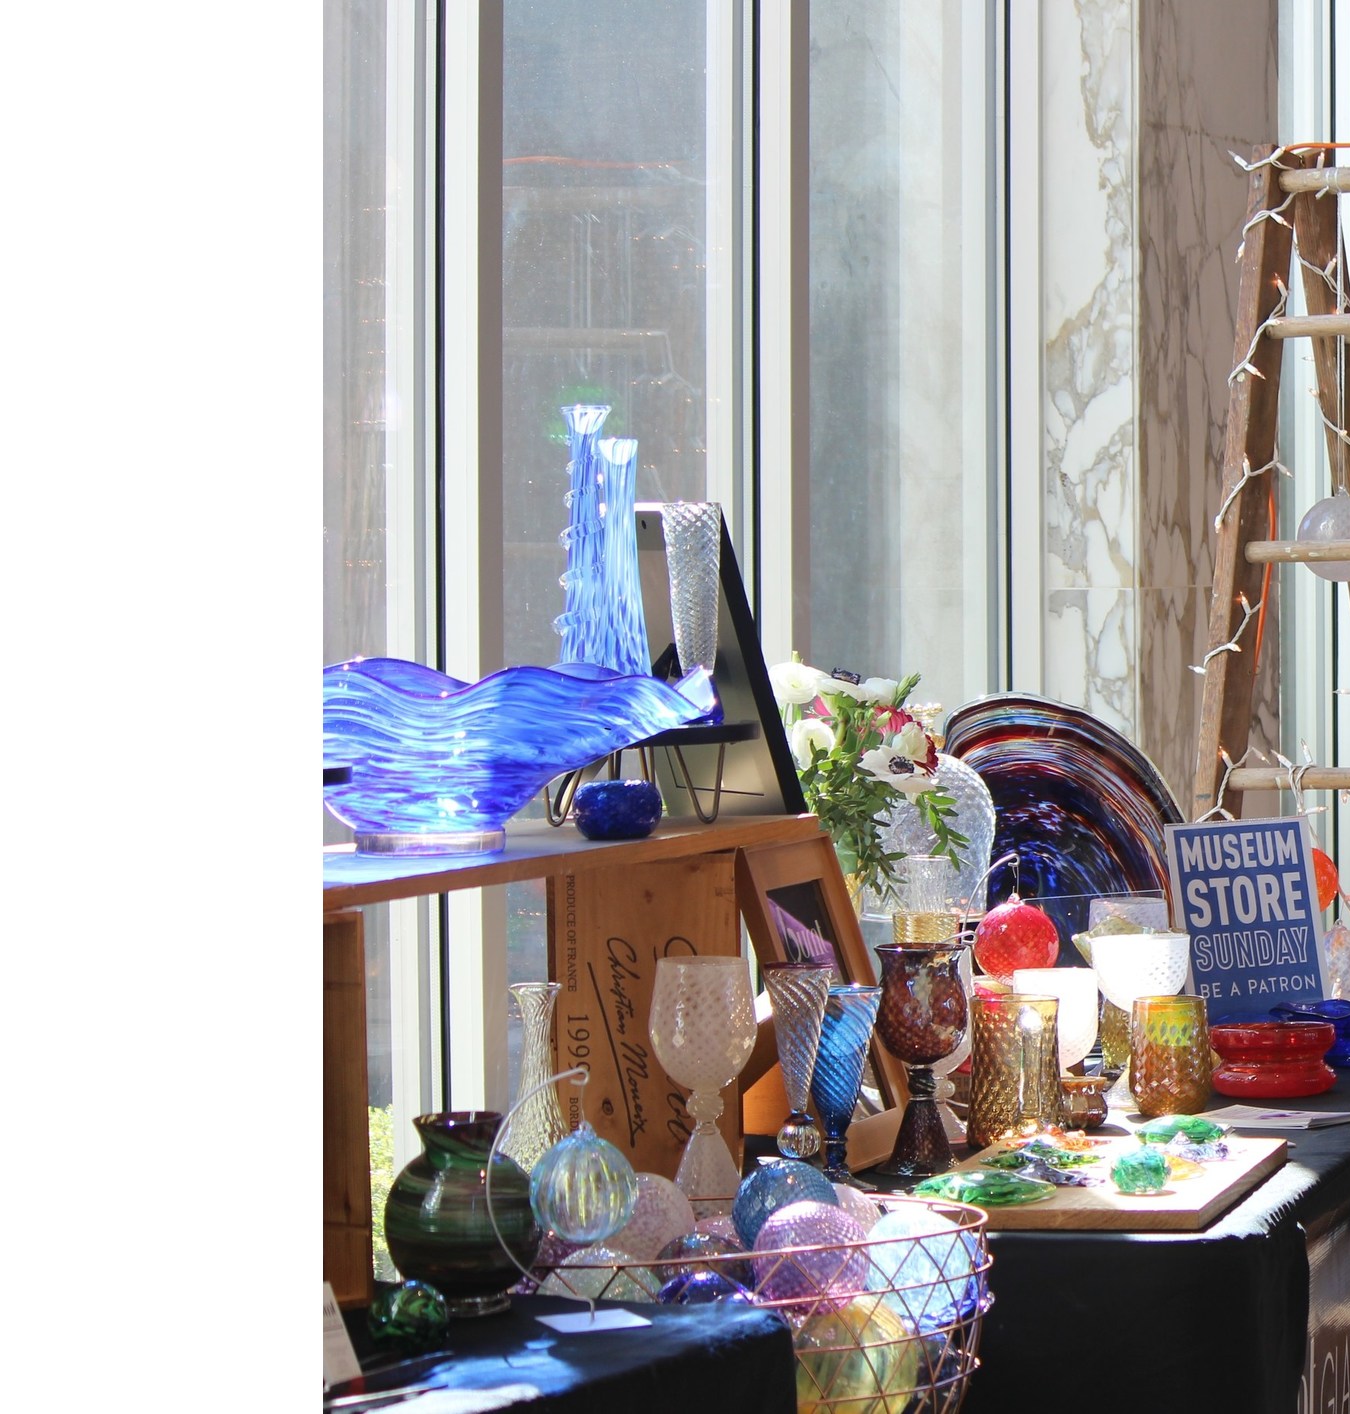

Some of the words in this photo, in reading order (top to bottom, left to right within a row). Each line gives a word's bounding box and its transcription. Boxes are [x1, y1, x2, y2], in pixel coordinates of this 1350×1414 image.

[1179, 829, 1299, 873] MUSEUM
[565, 874, 577, 927] PRODUCE
[1186, 871, 1306, 928] STORE
[566, 929, 577, 945] OF
[1193, 926, 1309, 972] SUNDAY
[567, 947, 578, 993] FRANCE
[1200, 982, 1223, 999] BE
[1230, 981, 1241, 997] A
[1248, 974, 1317, 996] PATRON
[569, 1096, 580, 1133] BORD
